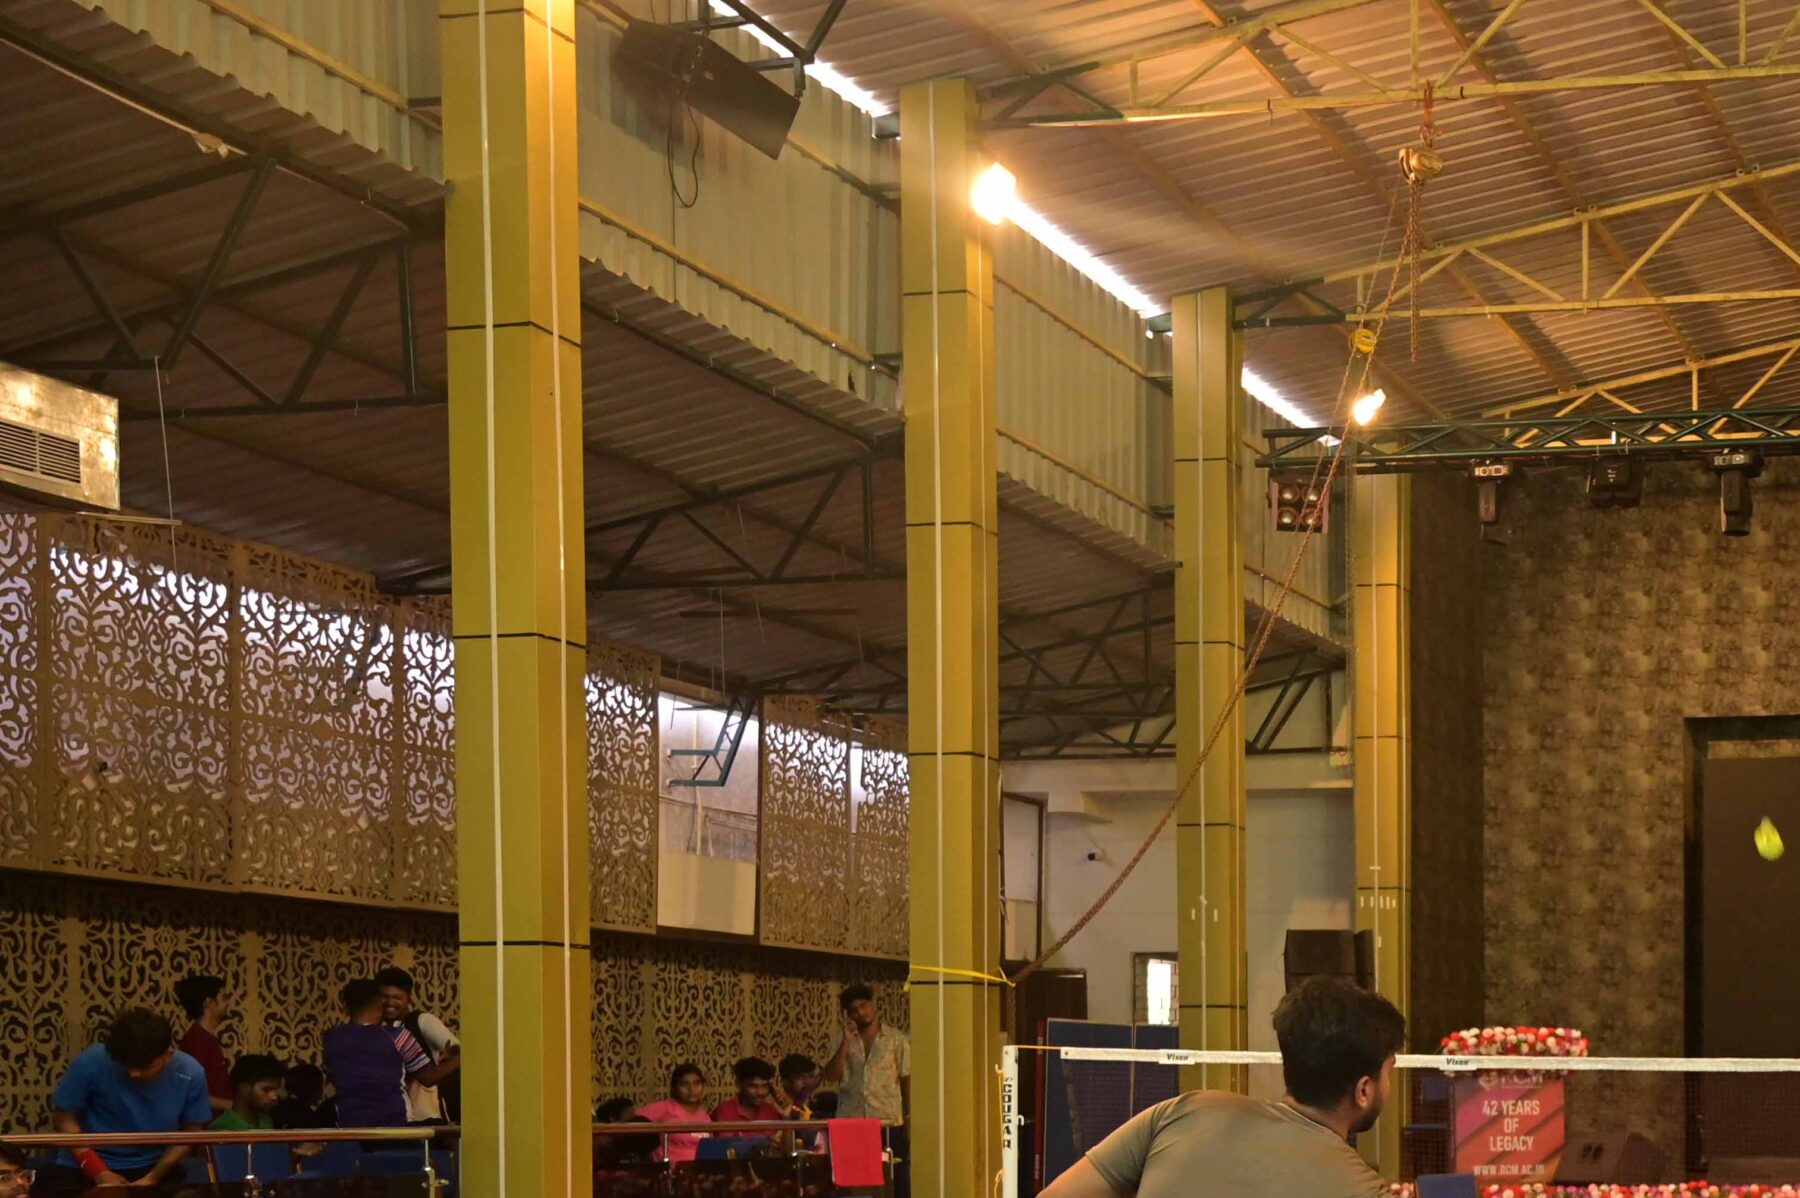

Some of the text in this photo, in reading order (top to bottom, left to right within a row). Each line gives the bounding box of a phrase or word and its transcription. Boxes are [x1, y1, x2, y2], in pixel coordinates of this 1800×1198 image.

[1446, 1057, 1470, 1066] Vixen
[1482, 1099, 1540, 1116] 42 YEARS
[1503, 1117, 1520, 1133] OF
[1489, 1135, 1534, 1152] LEGACY
